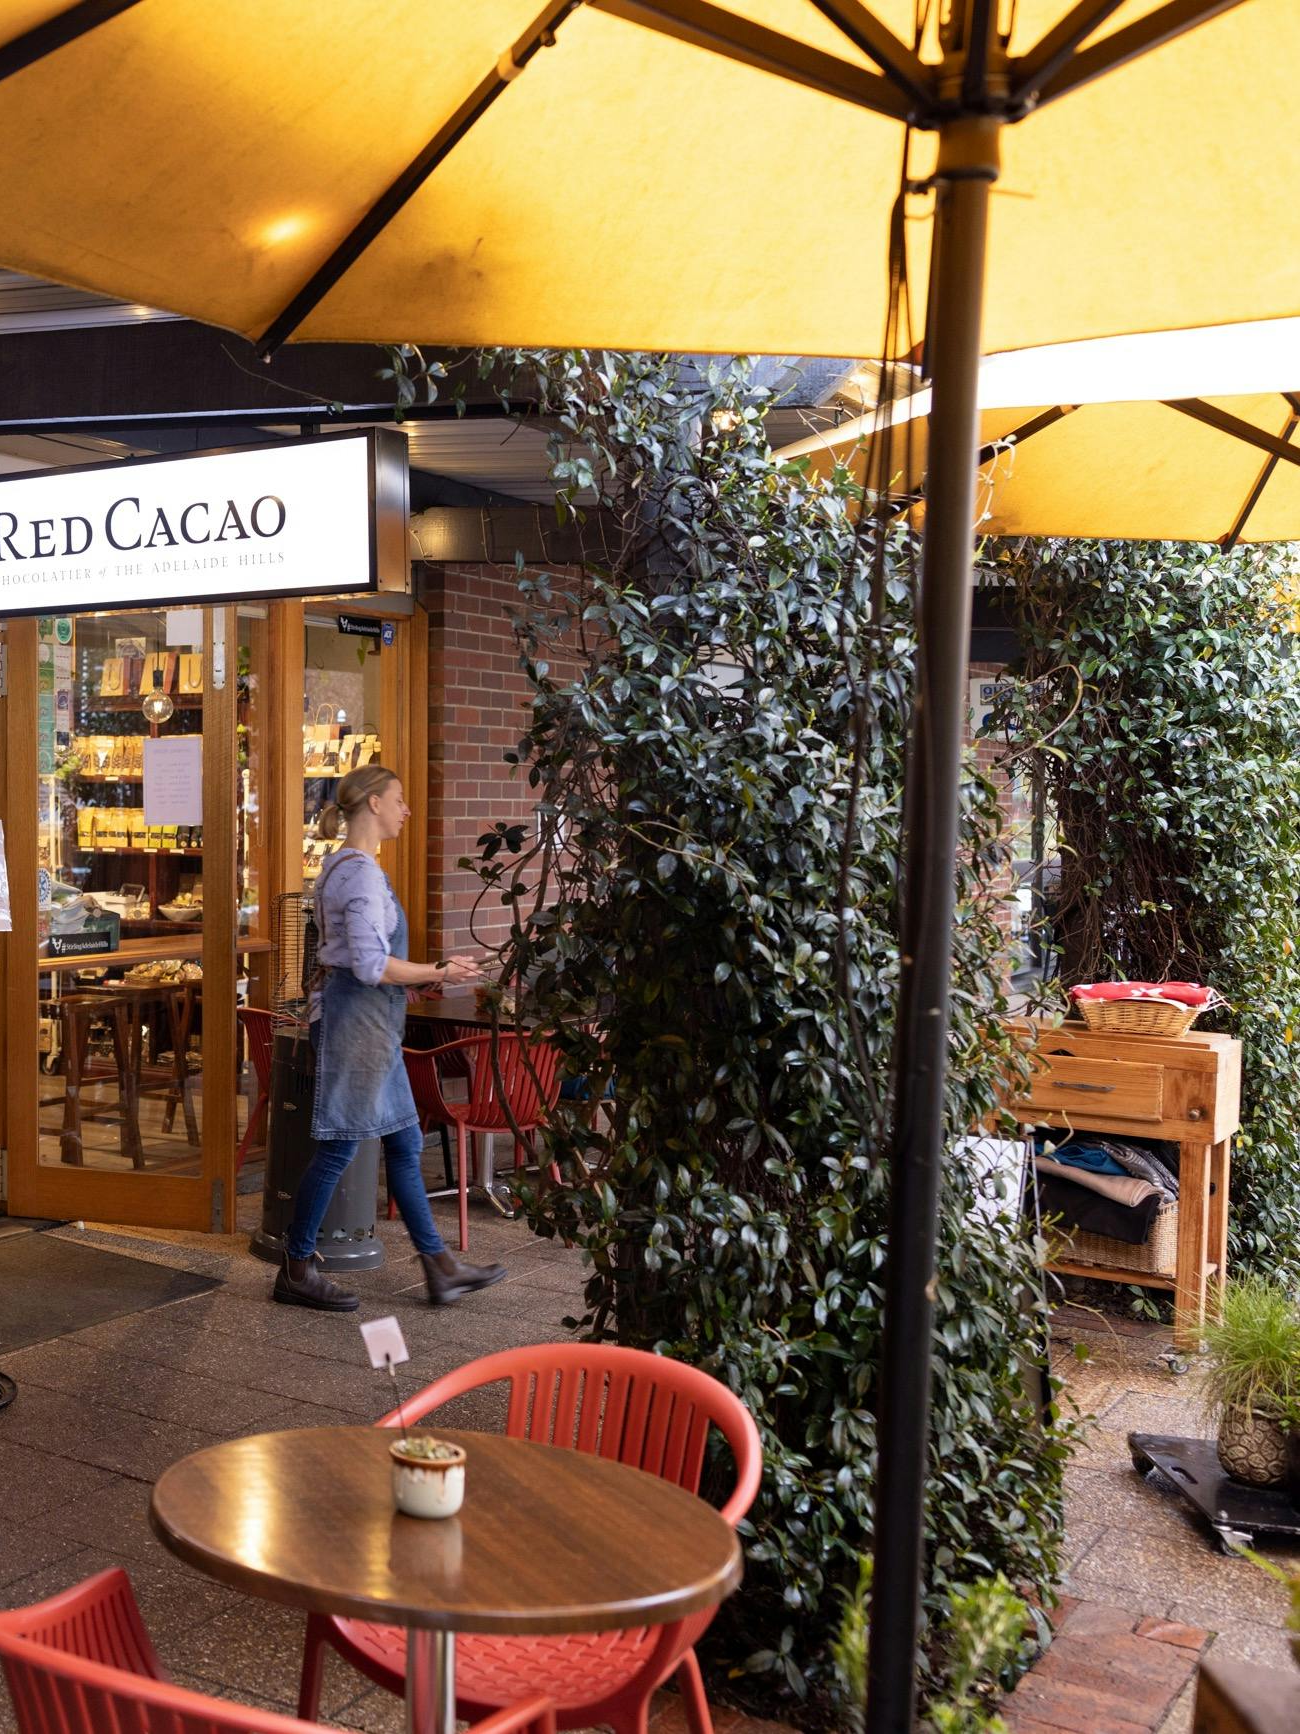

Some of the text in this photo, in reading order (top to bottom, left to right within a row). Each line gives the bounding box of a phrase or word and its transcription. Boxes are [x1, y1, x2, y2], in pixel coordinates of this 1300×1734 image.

[104, 494, 287, 551] CACAO
[115, 562, 143, 577] THE
[152, 556, 229, 574] ADELAIDE
[238, 551, 286, 567] HILLS
